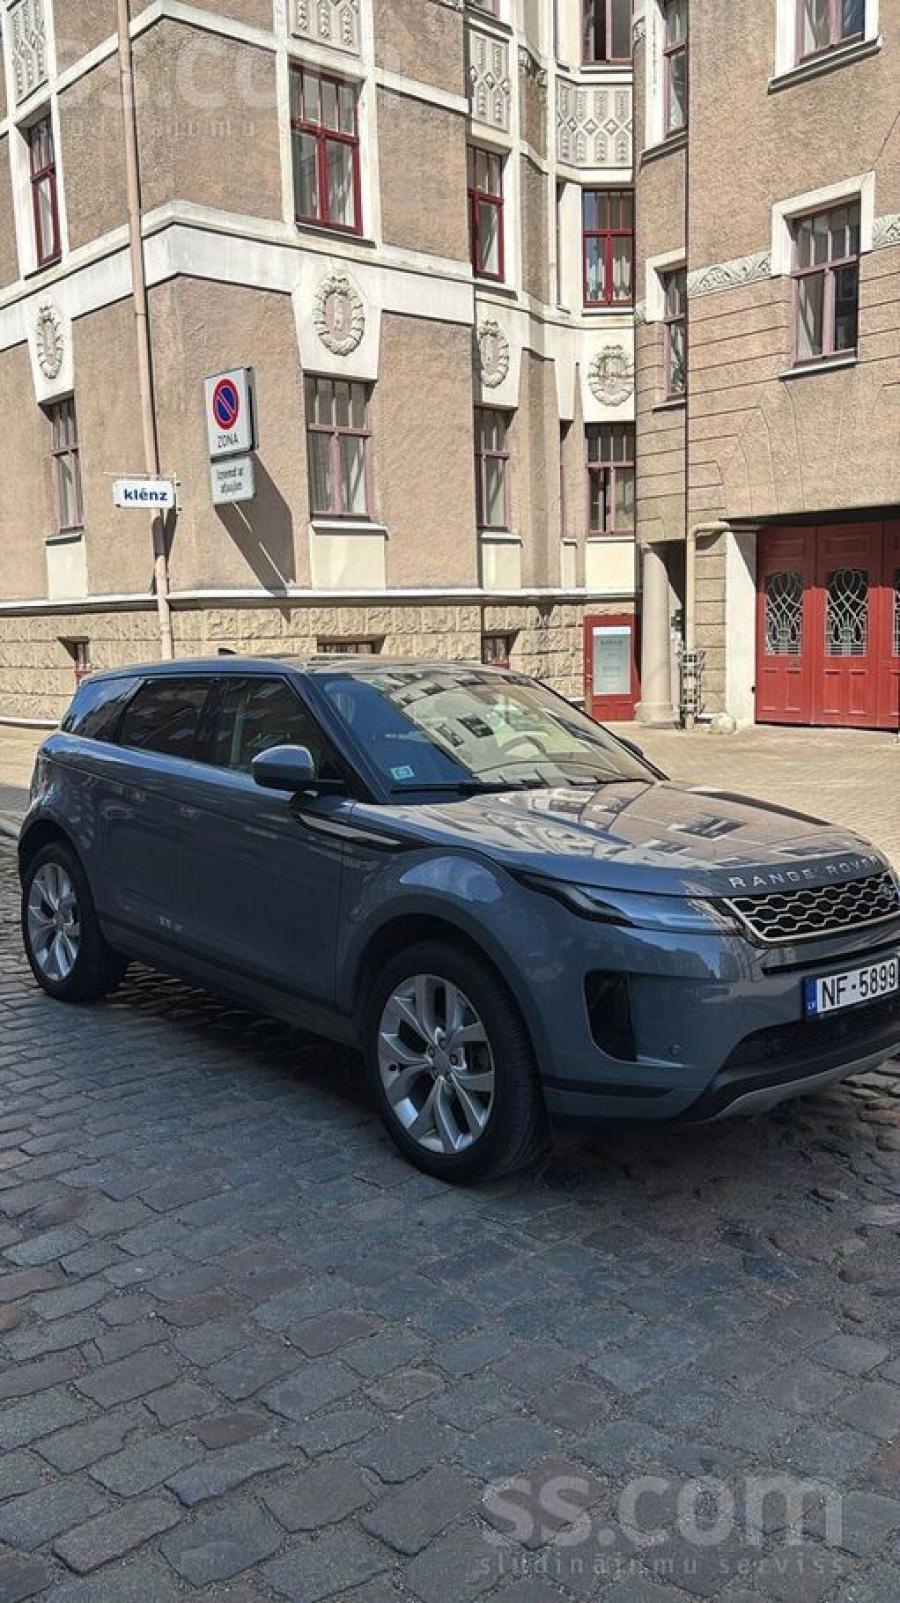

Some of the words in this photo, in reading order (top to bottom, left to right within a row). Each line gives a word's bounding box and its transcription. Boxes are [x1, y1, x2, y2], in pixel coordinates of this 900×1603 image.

[216, 431, 239, 448] ZONA
[728, 868, 815, 889] RANGE
[826, 855, 883, 875] ROVER
[822, 961, 897, 1009] NF-5899
